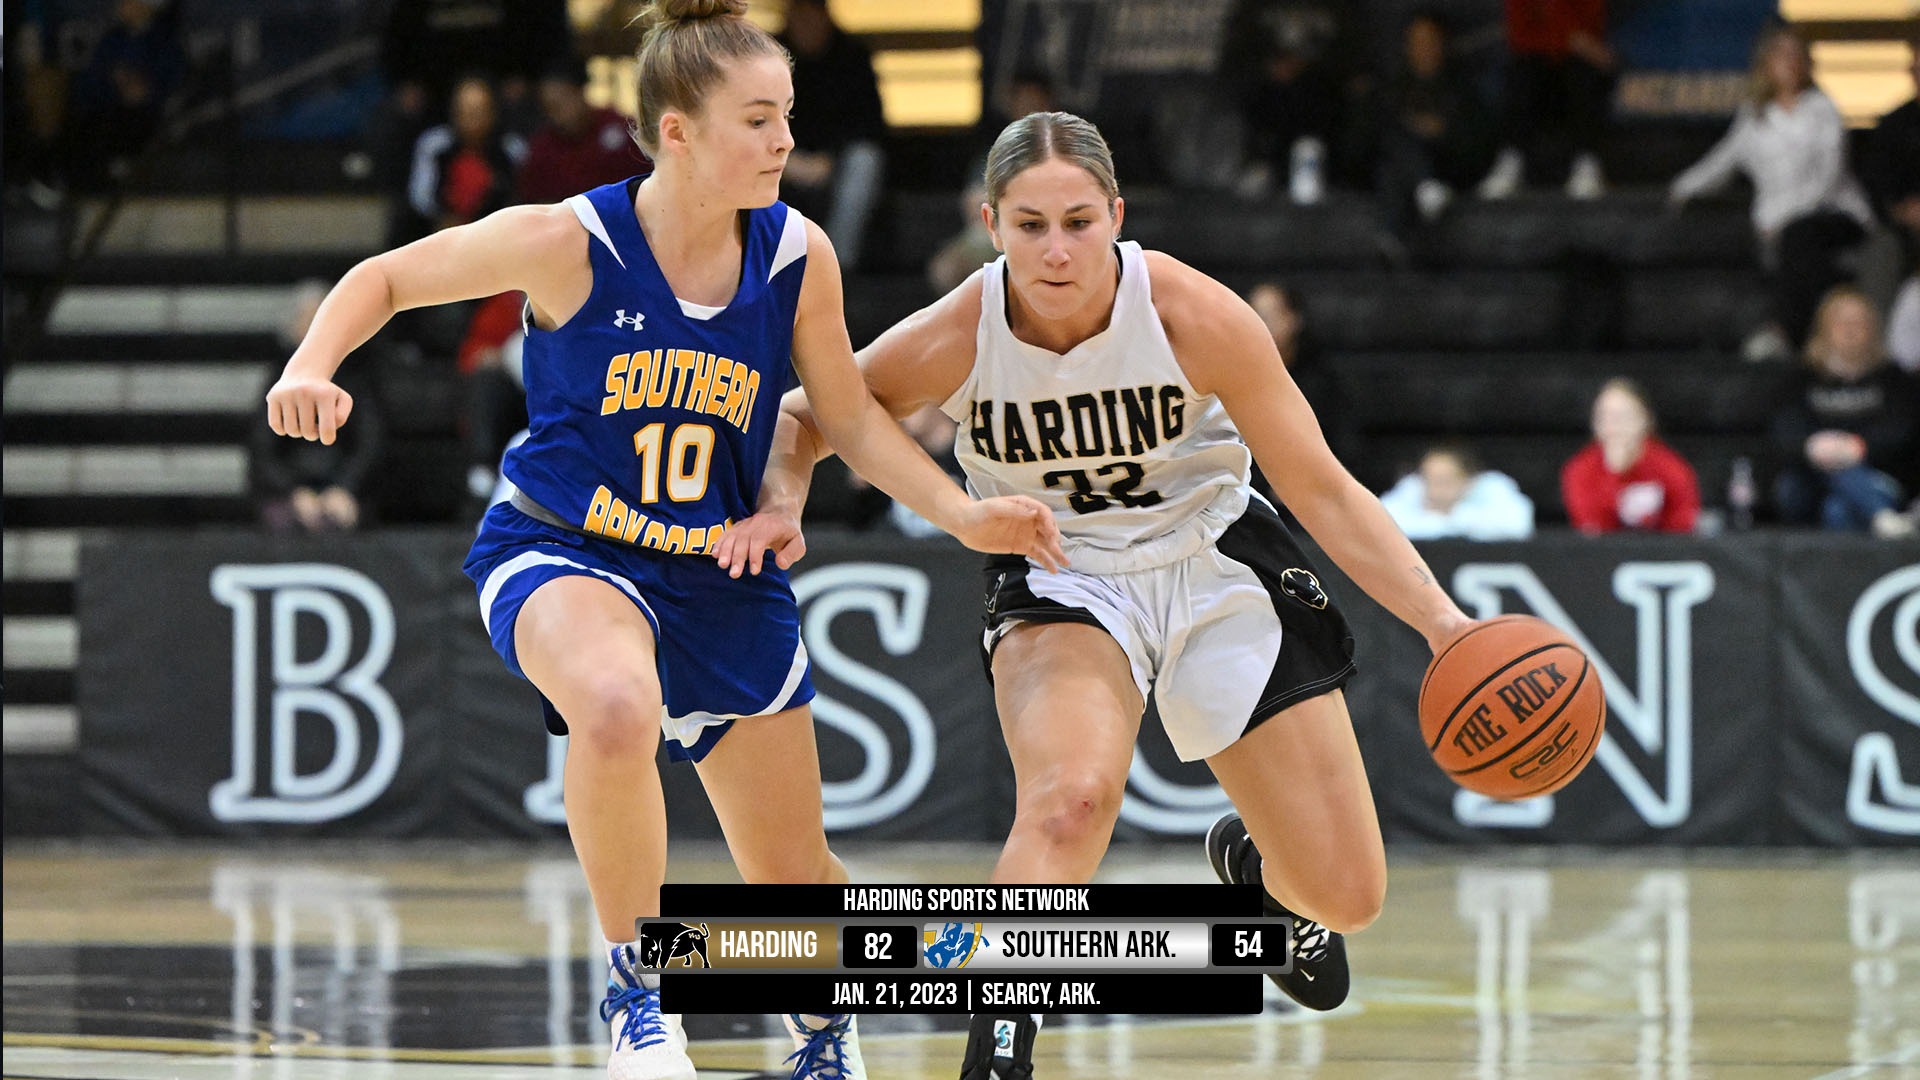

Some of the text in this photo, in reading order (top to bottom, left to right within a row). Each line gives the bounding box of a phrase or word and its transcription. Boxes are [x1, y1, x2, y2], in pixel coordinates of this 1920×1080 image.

[600, 348, 760, 434] SOUTHERN
[970, 385, 1184, 463] HARDING
[633, 423, 715, 504] 10
[1453, 662, 1567, 758] THE ROCK
